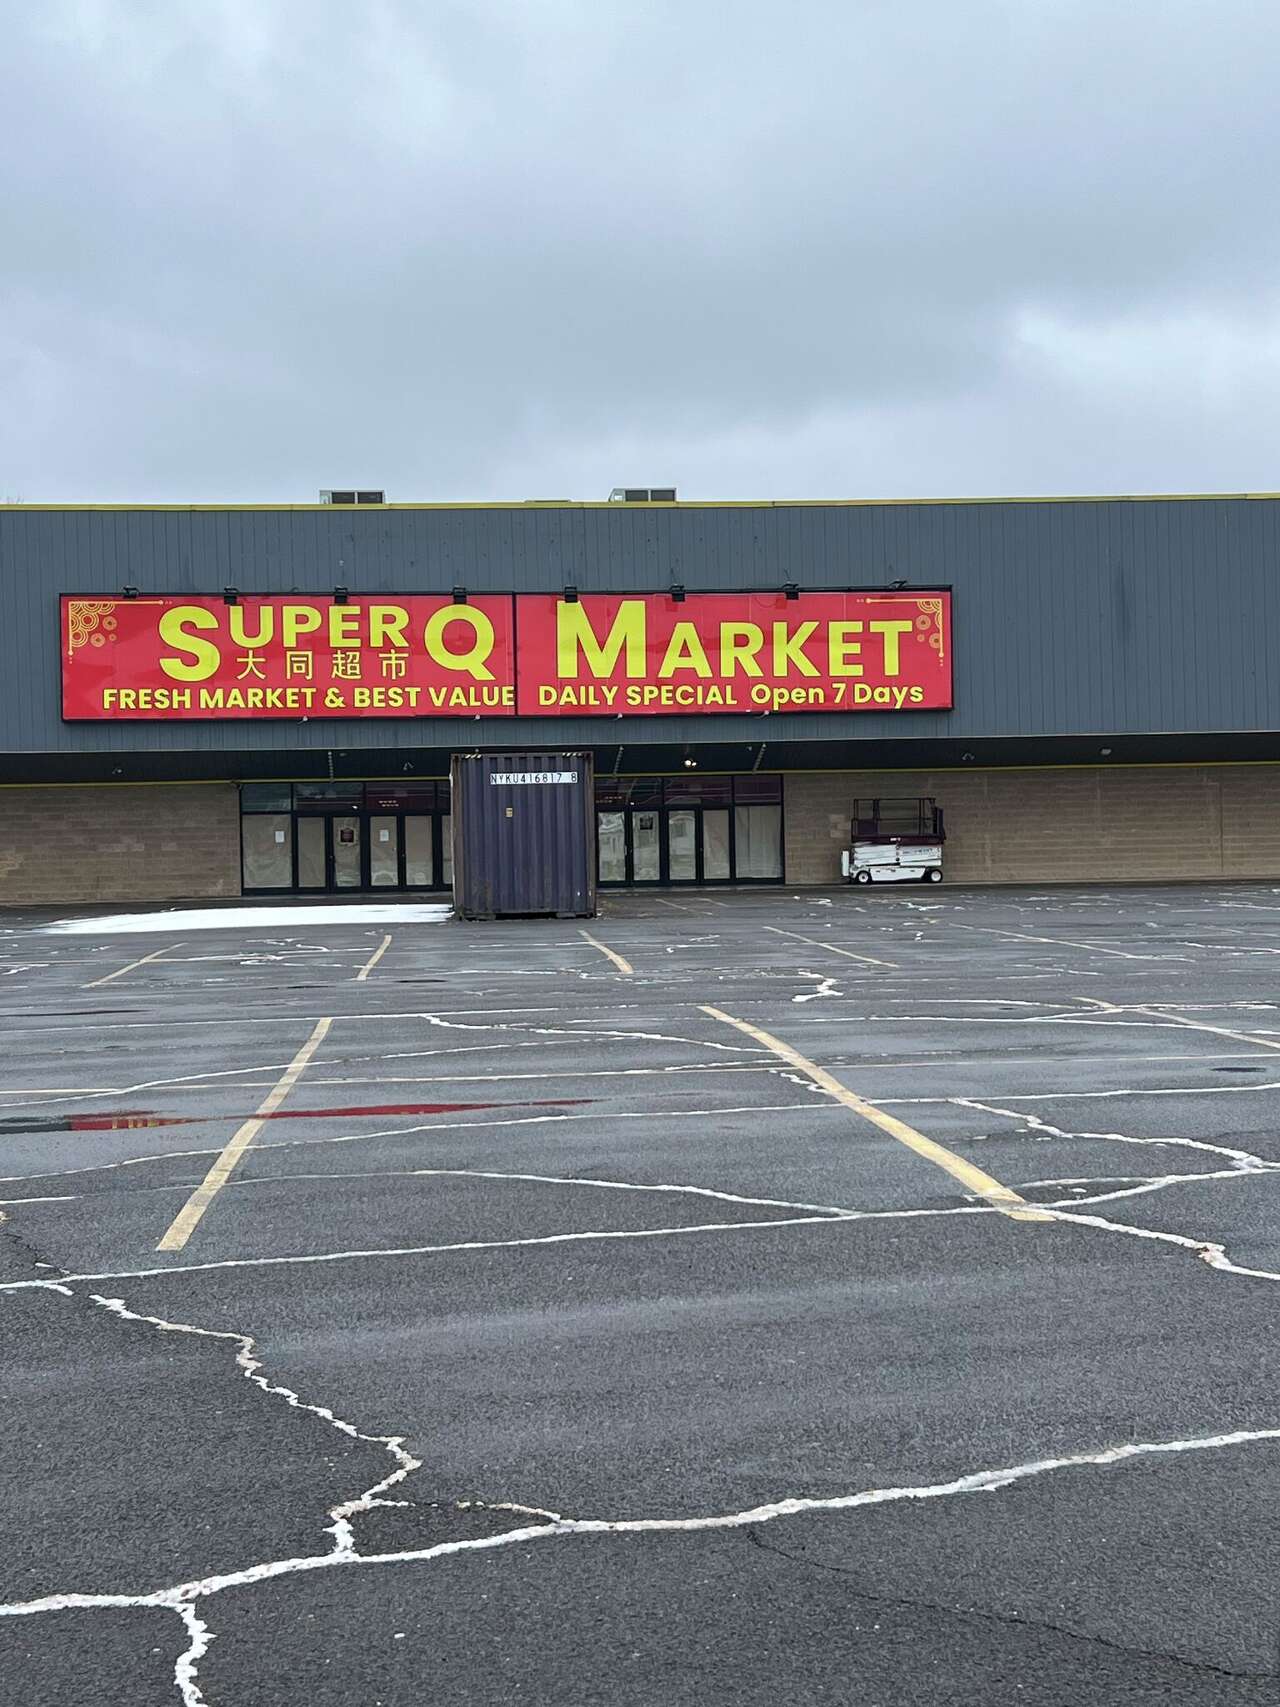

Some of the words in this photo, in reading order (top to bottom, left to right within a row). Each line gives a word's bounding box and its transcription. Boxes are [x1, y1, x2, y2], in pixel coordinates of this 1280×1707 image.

[158, 604, 409, 682] SUPER
[556, 600, 913, 679] MARKET
[236, 649, 408, 681] 大同超市
[103, 688, 192, 710] FRESH
[199, 687, 316, 709] MARKET
[324, 687, 346, 708] &
[353, 686, 421, 708] BEST
[429, 685, 516, 707] VALUE
[538, 685, 618, 706] DAILY
[626, 685, 738, 706] SPECIAL
[750, 683, 825, 711] Open
[832, 683, 846, 704] 7
[853, 682, 924, 710] Days
[571, 772, 577, 783] 8
